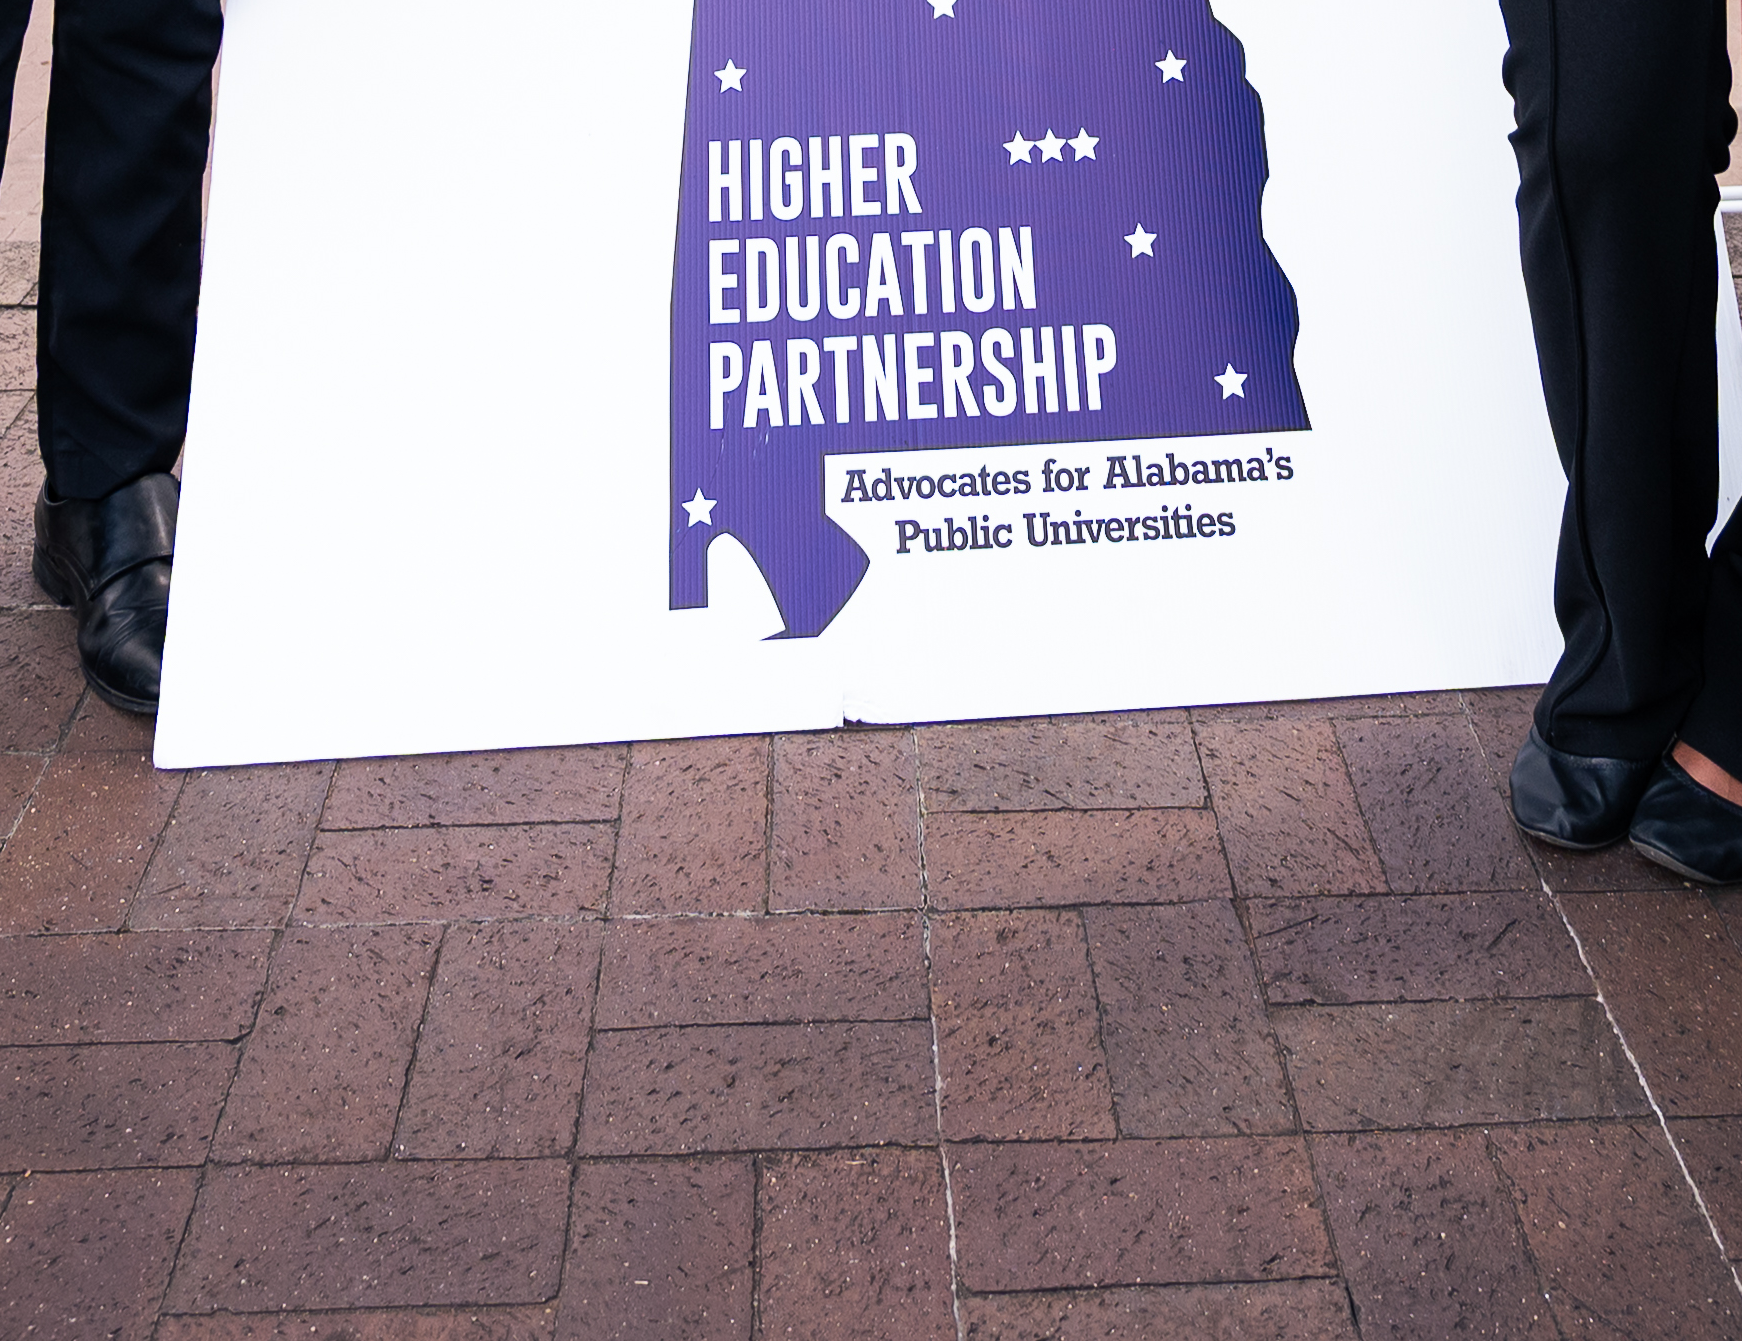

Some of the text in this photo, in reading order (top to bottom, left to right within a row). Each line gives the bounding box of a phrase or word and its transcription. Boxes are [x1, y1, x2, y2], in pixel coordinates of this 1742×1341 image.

[708, 132, 923, 223] HIGHER
[708, 226, 1037, 325] EDUCATION
[708, 324, 1118, 430] PARTNERSHIP
[840, 447, 1295, 504] Advocates for Alabama's
[894, 503, 1237, 555] Public Universities
